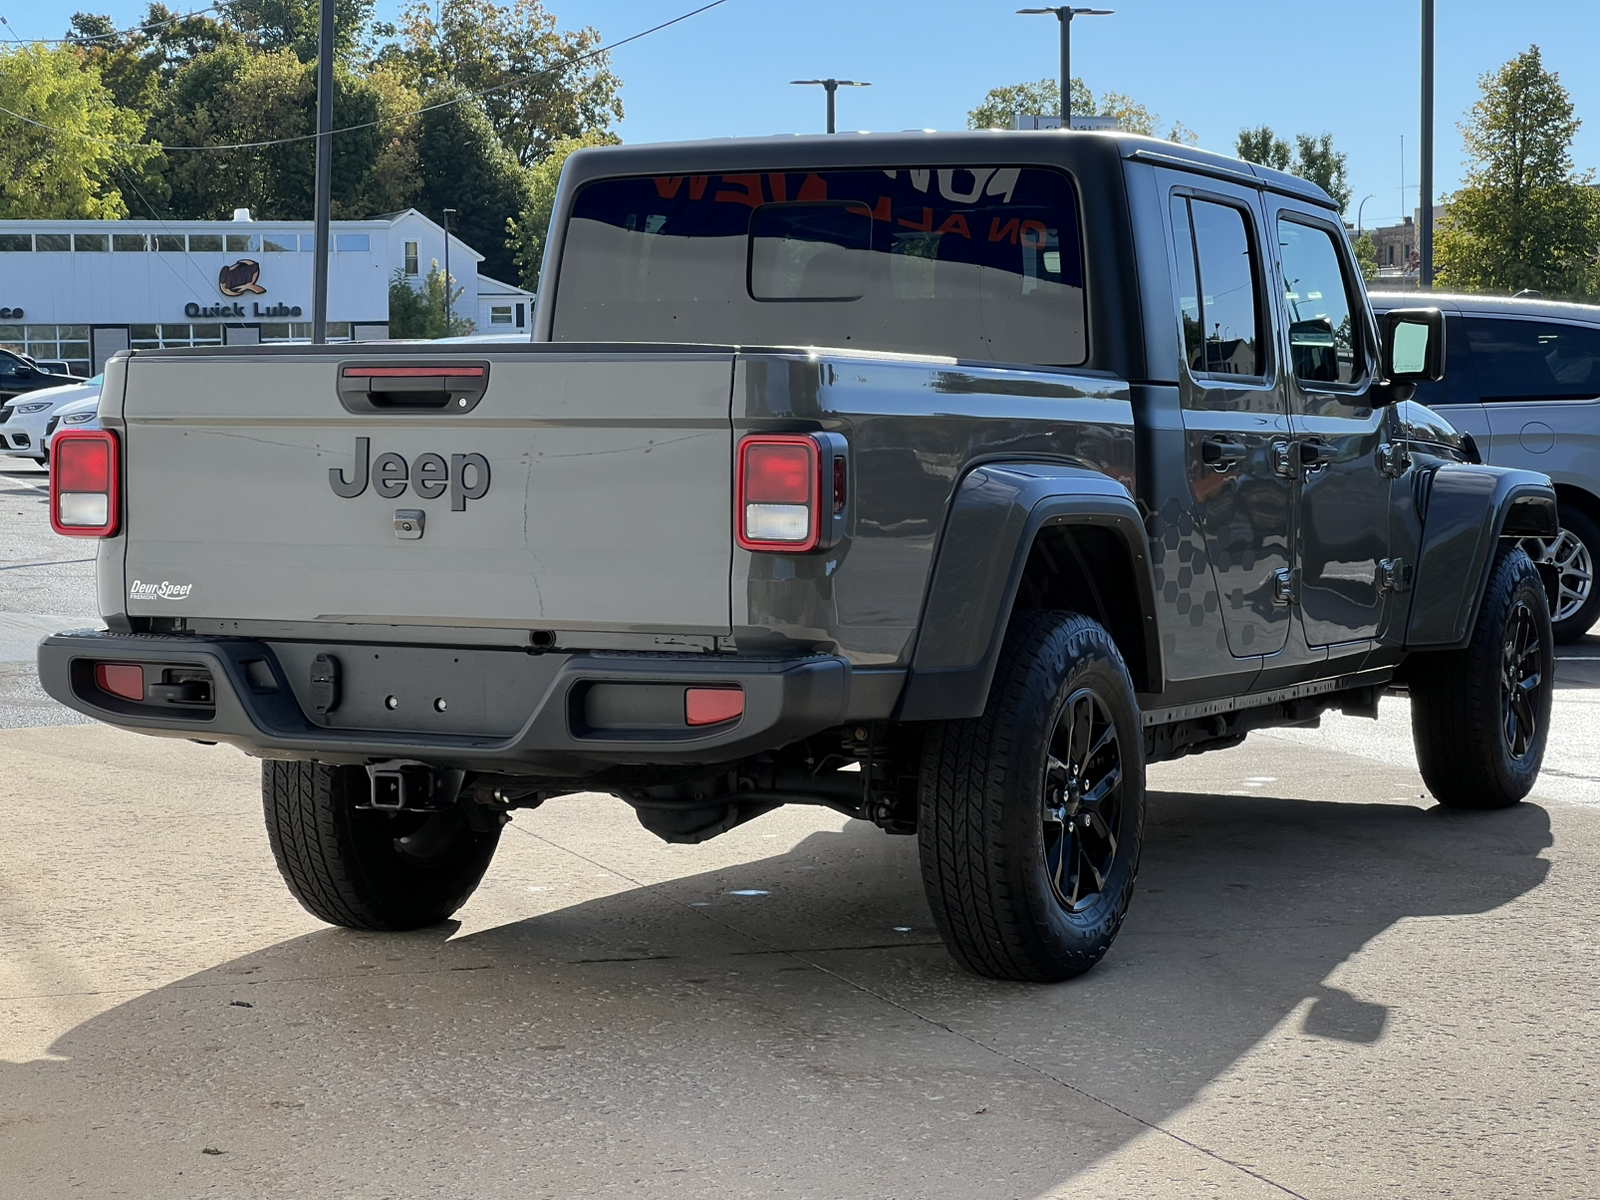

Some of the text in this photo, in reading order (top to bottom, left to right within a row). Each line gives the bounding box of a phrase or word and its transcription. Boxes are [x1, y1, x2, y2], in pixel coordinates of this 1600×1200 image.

[184, 302, 303, 318] Quick Lube
[328, 436, 492, 512] Jeep
[130, 580, 193, 598] Deur Speet
